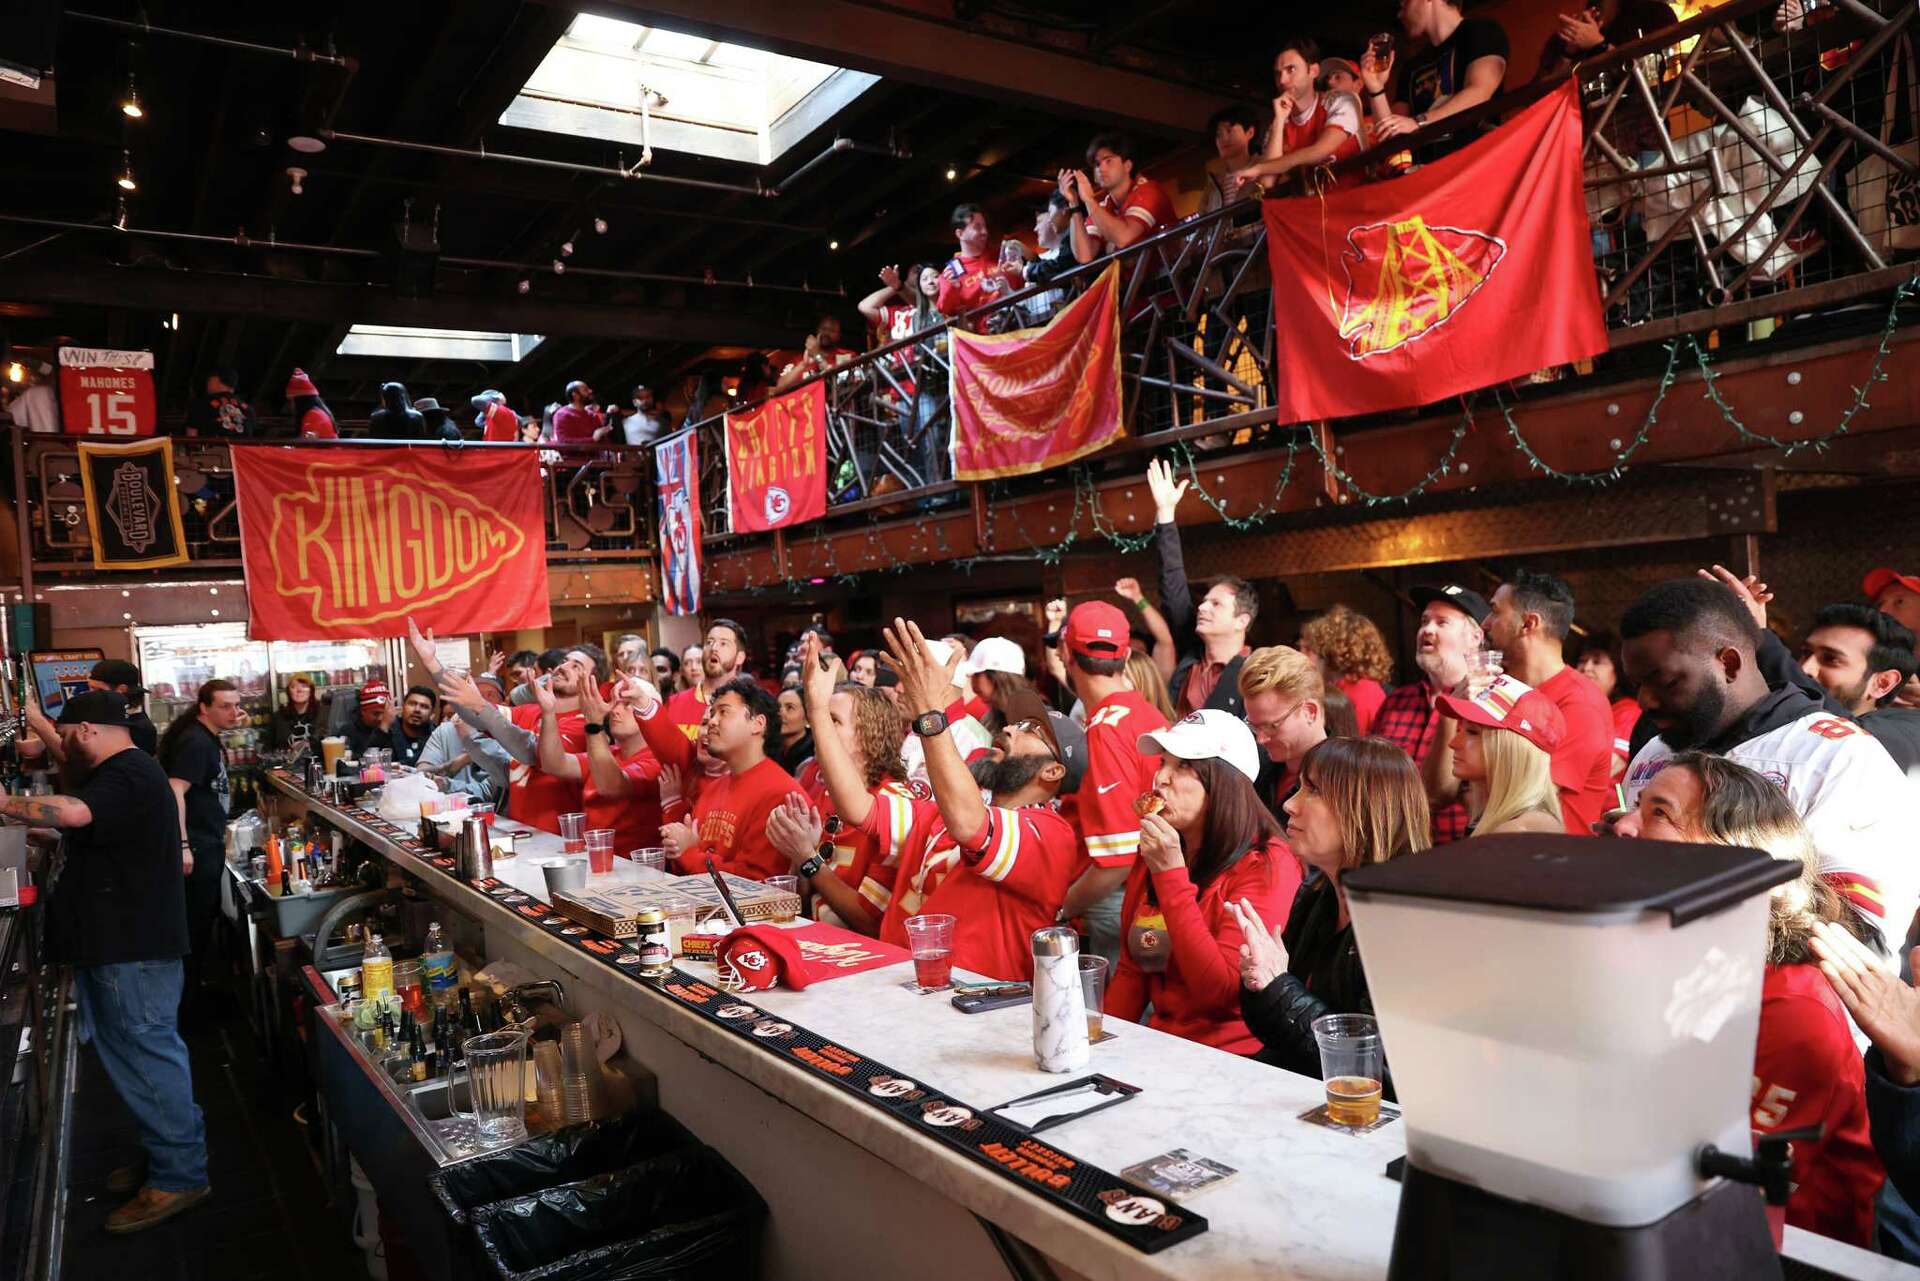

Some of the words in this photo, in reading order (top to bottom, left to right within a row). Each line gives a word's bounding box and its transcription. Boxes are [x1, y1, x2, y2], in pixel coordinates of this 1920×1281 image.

[63, 350, 97, 363] WIN
[80, 376, 136, 389] MAHOMES
[86, 393, 137, 435] 15
[121, 472, 149, 539] BOULEVARD
[295, 477, 506, 609] KINGDOM
[683, 939, 712, 950] CHIEFS
[976, 1142, 1073, 1190] BULLEIT
[1097, 1188, 1183, 1232] GIANTS
